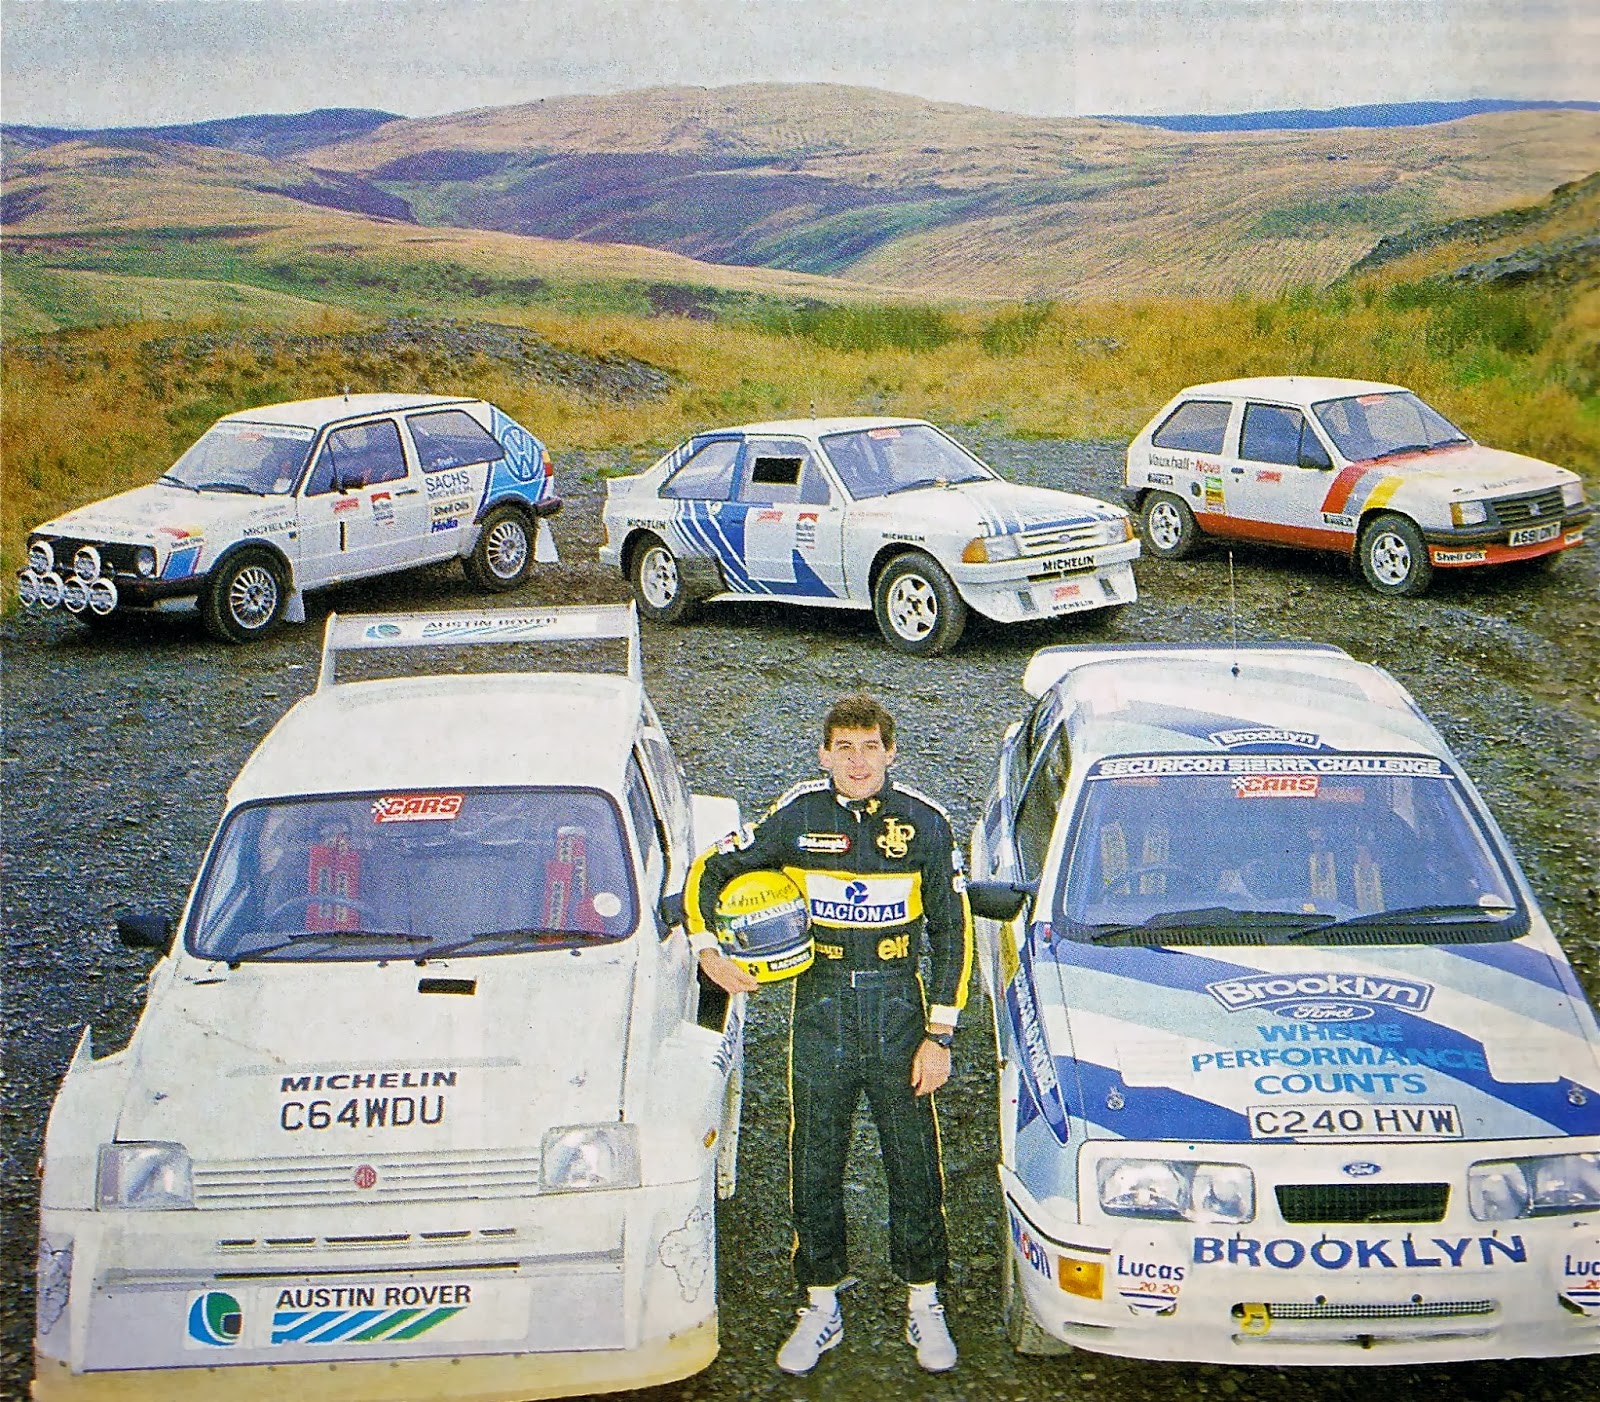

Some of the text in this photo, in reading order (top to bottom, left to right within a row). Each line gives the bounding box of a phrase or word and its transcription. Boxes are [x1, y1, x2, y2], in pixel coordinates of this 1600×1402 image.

[425, 470, 469, 491] SACHS
[881, 532, 925, 542] MICHELIN
[1042, 555, 1095, 572] MICHELIN
[1436, 552, 1462, 562] Shell
[1052, 600, 1094, 611] MICHELIN
[1223, 730, 1314, 745] Brooklyn
[1099, 758, 1441, 775] SECURICOR SIERRA CHALLENGE
[1245, 775, 1316, 792] CARS
[384, 797, 461, 816] CARS
[815, 900, 904, 922] NACIONAL
[878, 934, 909, 960] elf
[1224, 974, 1420, 1004] Brooklyn
[1293, 1004, 1355, 1020] Ford
[1256, 1022, 1404, 1043] WHERE
[1191, 1046, 1487, 1072] PERFORMANCE
[280, 1071, 458, 1093] MICHELIN
[1254, 1073, 1428, 1095] COUNTS
[281, 1095, 444, 1131] C64WDU
[1255, 1108, 1455, 1135] C240 HVW
[1193, 1234, 1527, 1270] BROOKLYN
[1118, 1254, 1185, 1281] Lucas
[1565, 1254, 1600, 1276] Luc
[276, 1285, 472, 1310] AUSTIN ROVER
[1138, 1281, 1180, 1295] 20 20
